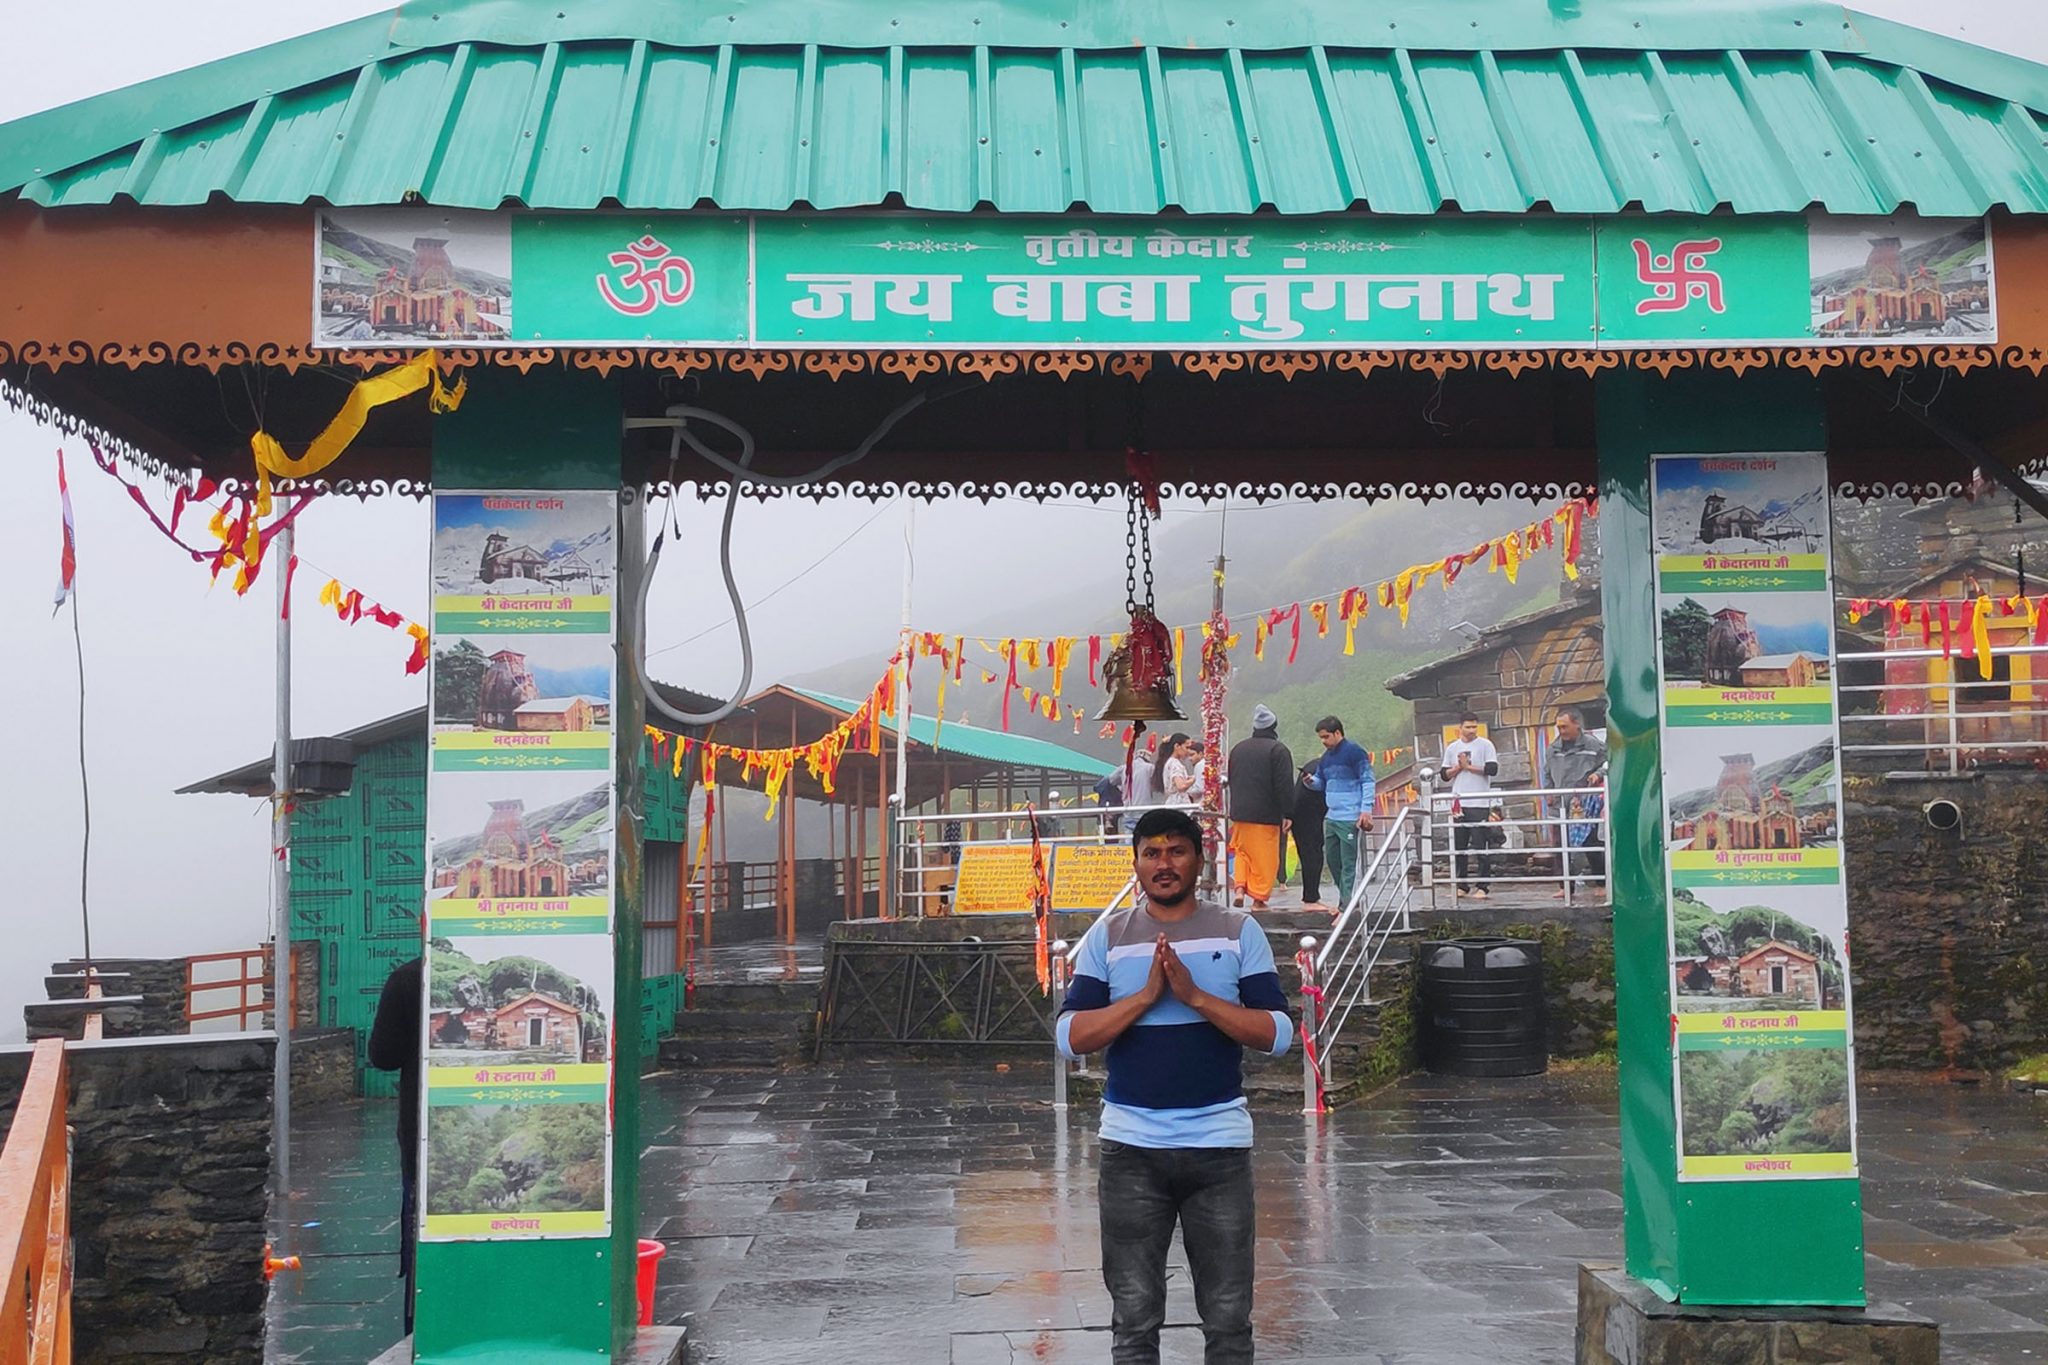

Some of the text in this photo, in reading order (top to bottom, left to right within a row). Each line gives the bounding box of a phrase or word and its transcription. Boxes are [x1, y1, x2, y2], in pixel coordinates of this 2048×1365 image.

[1024, 228, 1254, 266] तृतीय केदार
[786, 258, 1564, 340] जय बाबा तुंगनाथ
[535, 497, 564, 510] दर्शन
[1703, 556, 1789, 569] श्री केदारनाथ जी
[481, 597, 572, 611] श्री केदारनाथ जी
[1715, 851, 1728, 863] श्री
[478, 899, 491, 912] श्री
[1722, 1016, 1735, 1028] श्री
[1784, 1015, 1799, 1027] जी
[474, 1070, 489, 1083] श्री
[540, 1068, 556, 1081] जी
